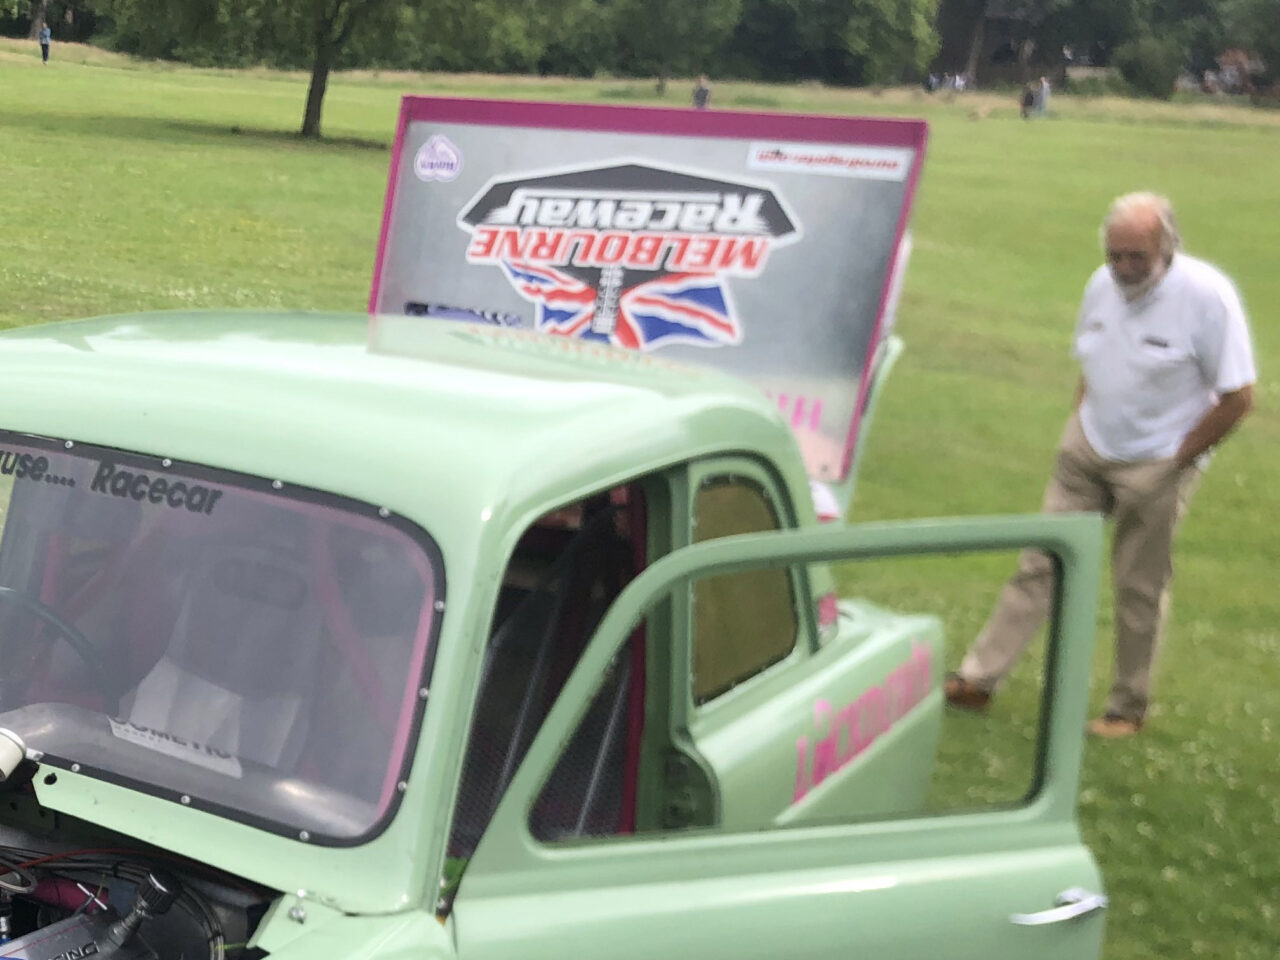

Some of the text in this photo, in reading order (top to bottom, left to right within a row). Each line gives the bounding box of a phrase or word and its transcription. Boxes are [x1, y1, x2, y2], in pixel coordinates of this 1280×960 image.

[486, 189, 770, 235] Raceway
[467, 228, 770, 271] MELBOURNE
[90, 459, 223, 516] Racecar
